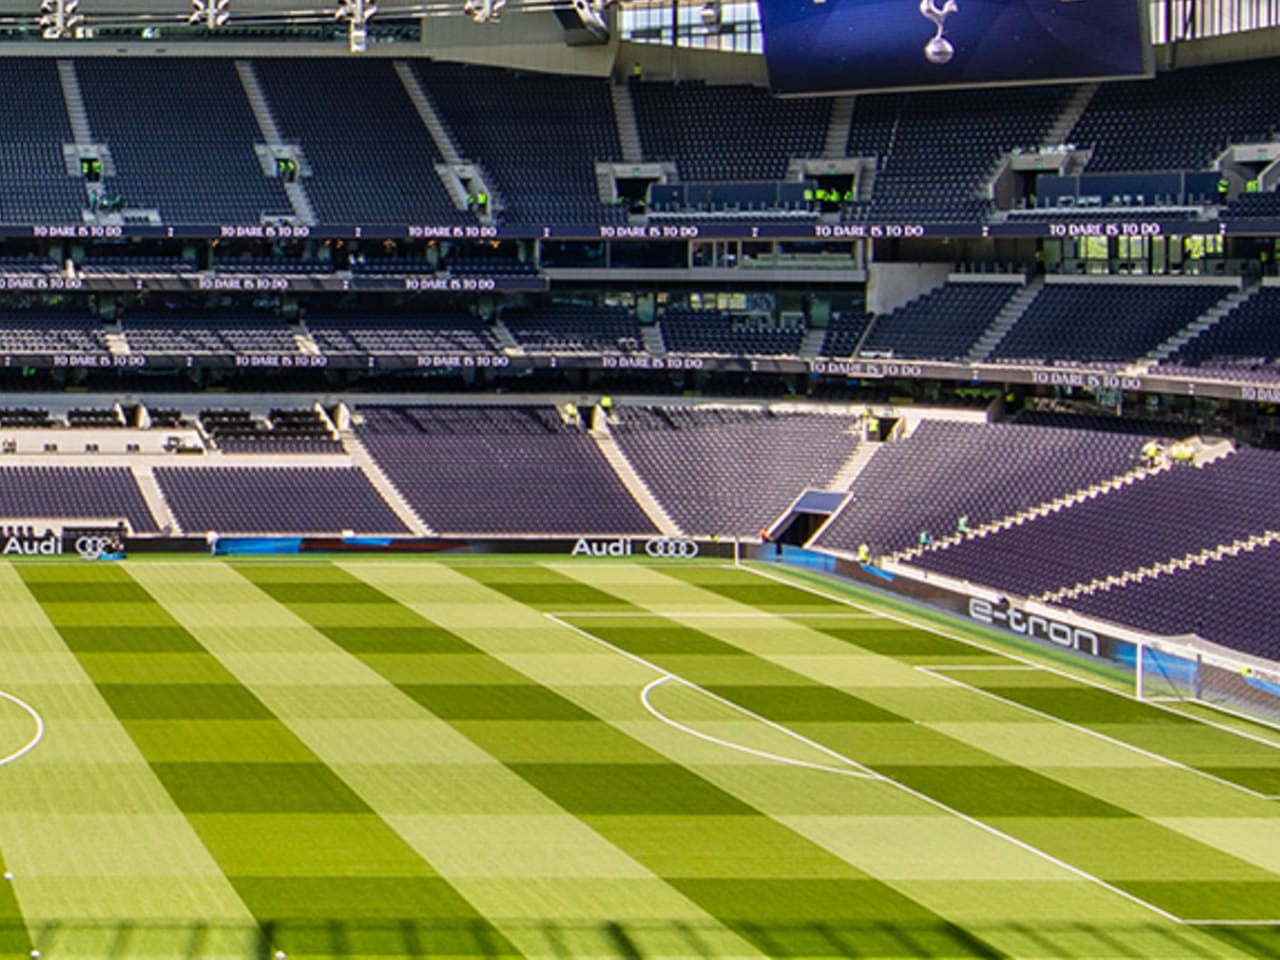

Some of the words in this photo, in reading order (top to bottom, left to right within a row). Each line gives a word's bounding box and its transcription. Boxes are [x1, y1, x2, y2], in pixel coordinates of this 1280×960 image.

[815, 225, 831, 236] TO
[834, 225, 867, 236] DARE
[871, 225, 883, 236] IS
[886, 225, 901, 236] TO
[905, 225, 924, 236] DO
[1050, 224, 1066, 236] TO
[1069, 224, 1101, 235] DARE
[1106, 224, 1118, 235] IS
[1122, 223, 1138, 235] TO
[1141, 223, 1160, 234] DO
[2, 536, 63, 555] Audi
[571, 538, 632, 557] Audi
[969, 597, 1099, 656] e-tron
